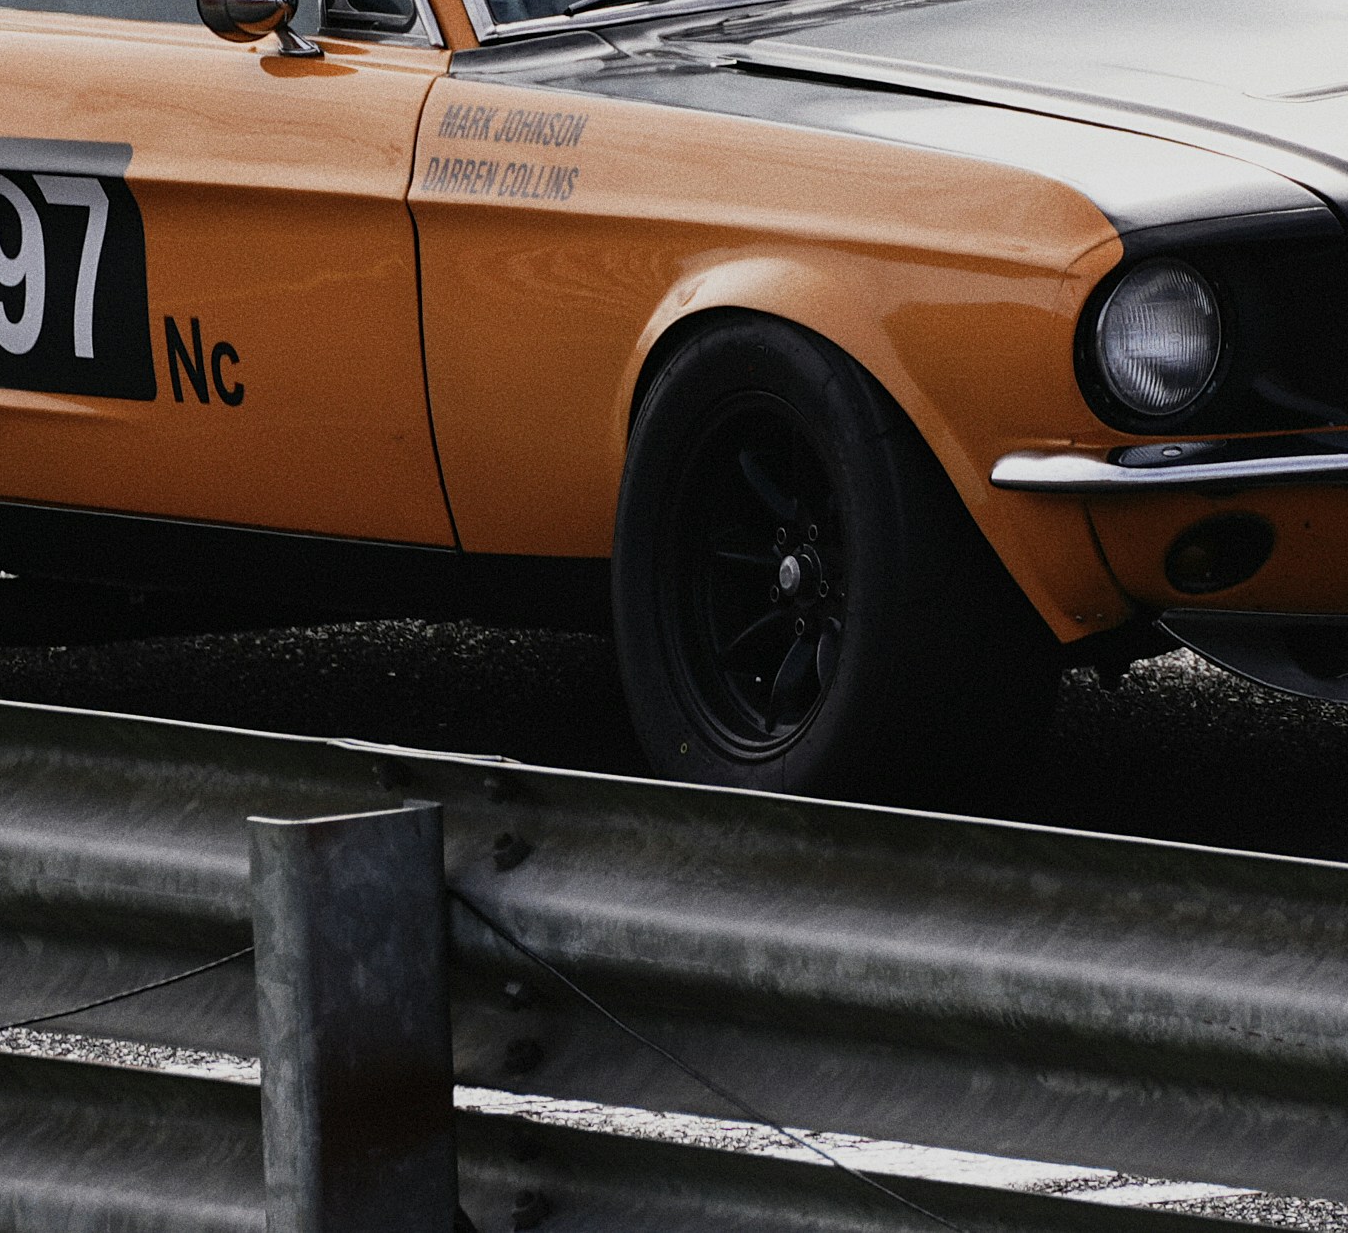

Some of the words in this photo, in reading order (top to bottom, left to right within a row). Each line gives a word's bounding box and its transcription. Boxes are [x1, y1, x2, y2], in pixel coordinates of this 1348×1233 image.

[438, 104, 498, 141] MARK
[494, 108, 589, 148] JOHNSON
[421, 156, 500, 195] DARREN
[497, 162, 579, 202] COLLINS
